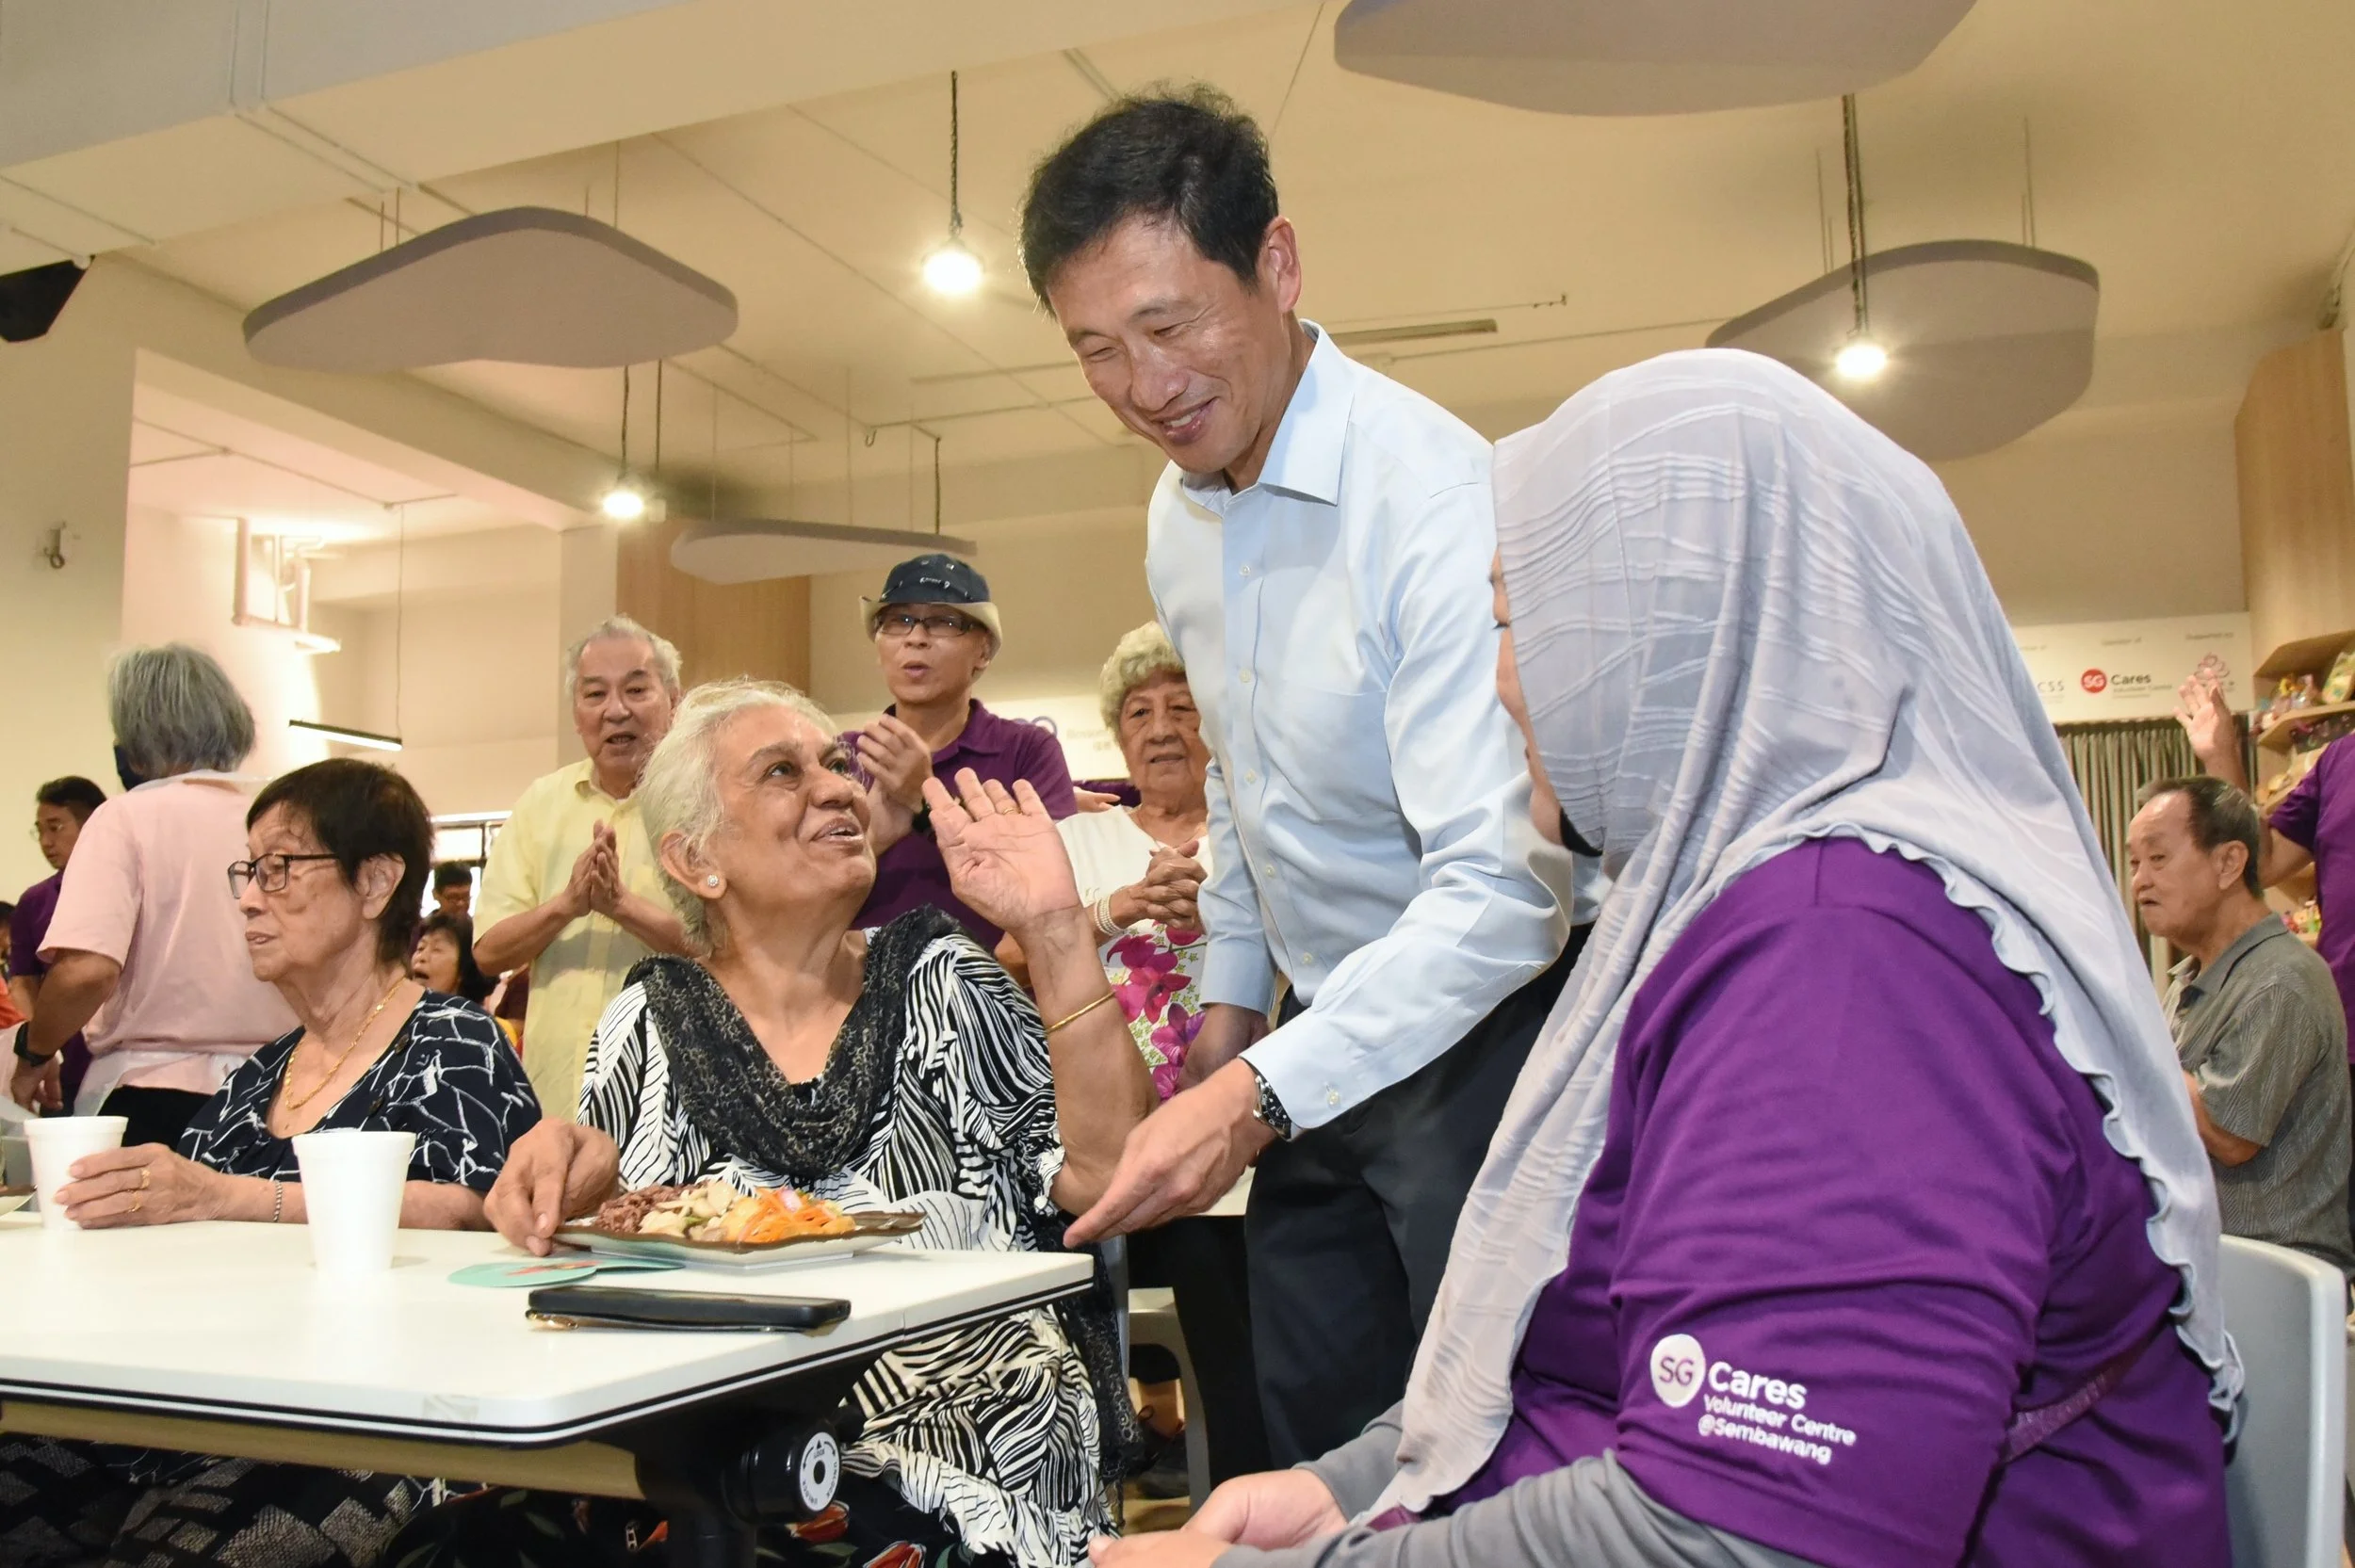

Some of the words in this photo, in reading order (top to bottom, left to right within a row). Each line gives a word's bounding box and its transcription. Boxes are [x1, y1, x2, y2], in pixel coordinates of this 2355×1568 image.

[2083, 674, 2105, 688] SG
[2111, 674, 2151, 686] Cares
[1659, 1356, 1695, 1387] SG
[1708, 1361, 1808, 1410] Cares
[1698, 1414, 1833, 1465] @Sembawang
[1703, 1394, 1789, 1429] Volunteer
[1791, 1414, 1857, 1447] Centre
